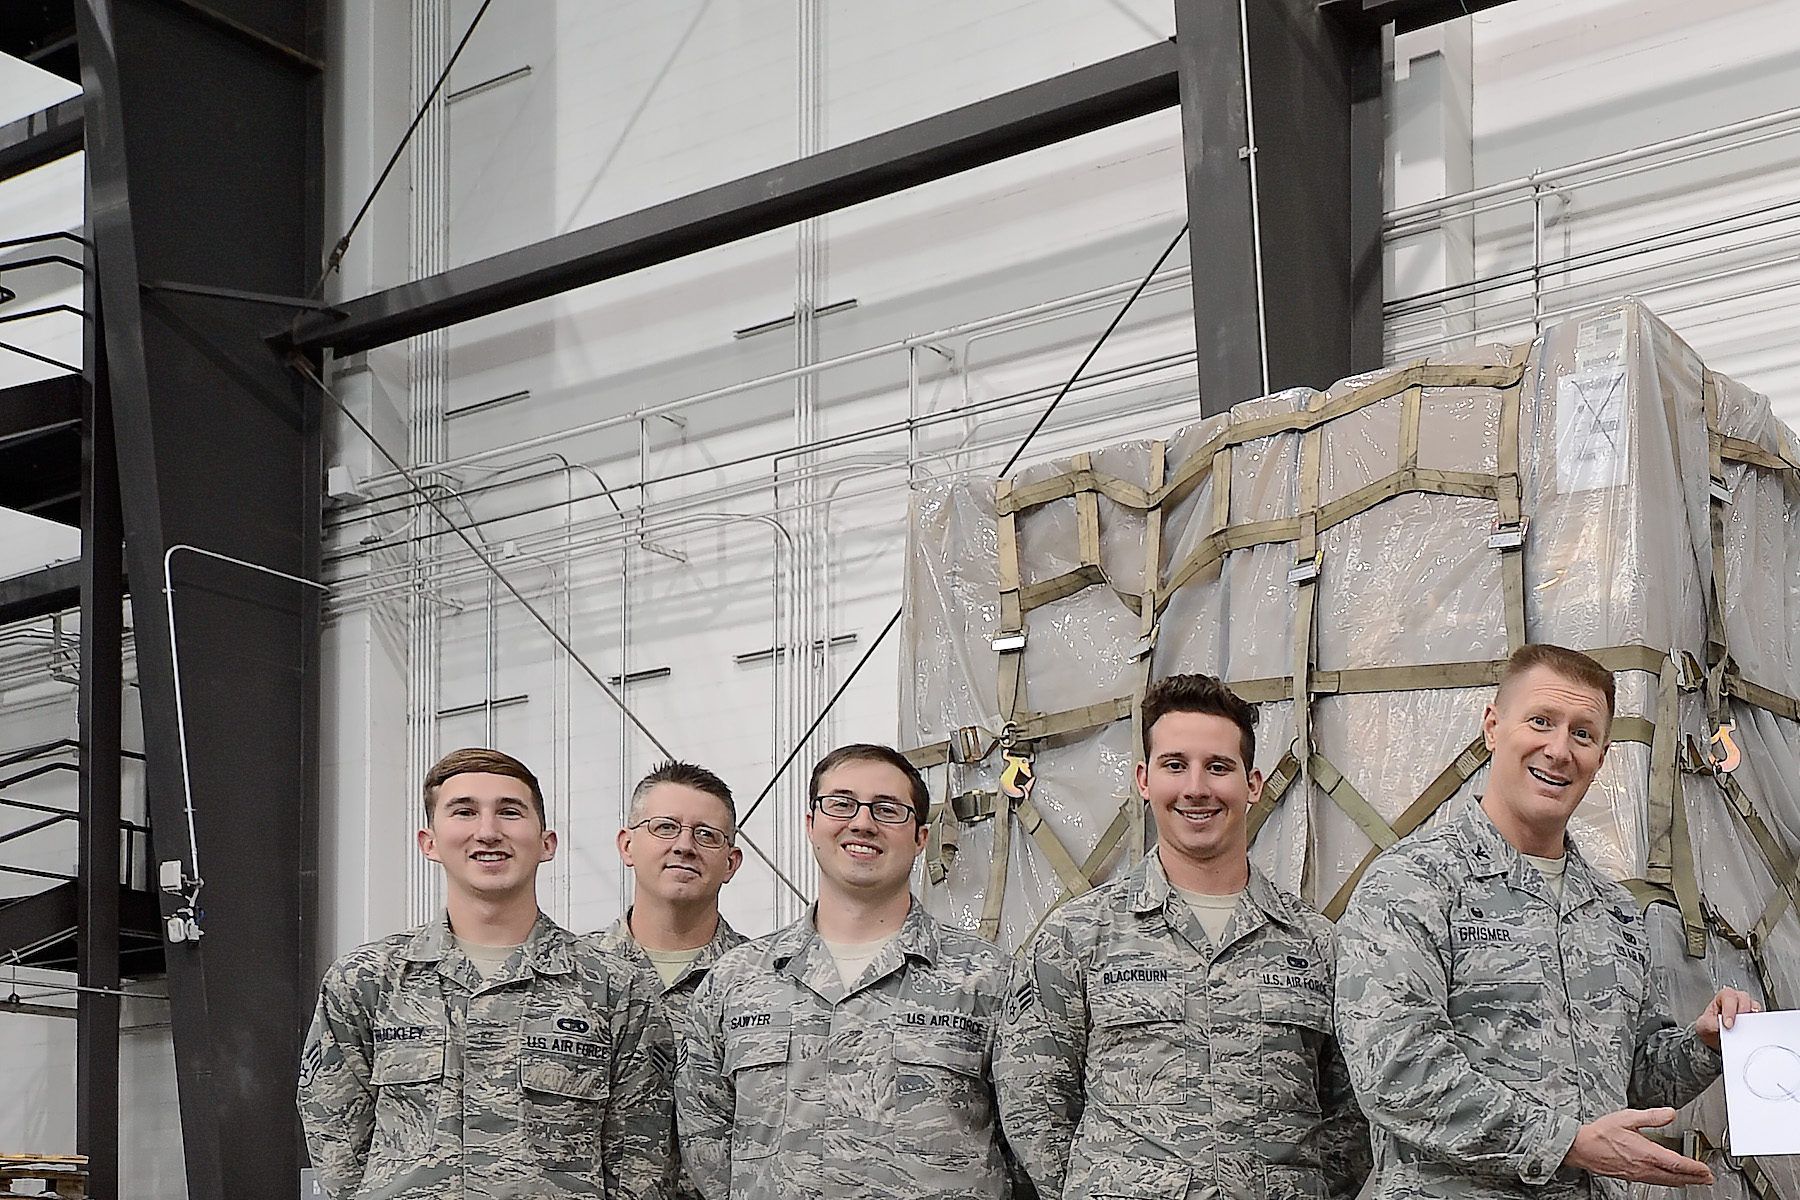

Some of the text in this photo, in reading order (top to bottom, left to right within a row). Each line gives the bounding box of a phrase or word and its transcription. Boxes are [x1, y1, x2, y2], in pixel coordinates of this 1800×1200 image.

[1459, 926, 1512, 941] GRISMER
[1103, 969, 1168, 985] BLACKBURN
[1262, 973, 1284, 986] U.S.
[1286, 975, 1302, 988] AIR
[929, 1014, 950, 1027] AIR
[551, 1038, 573, 1053] AIR
